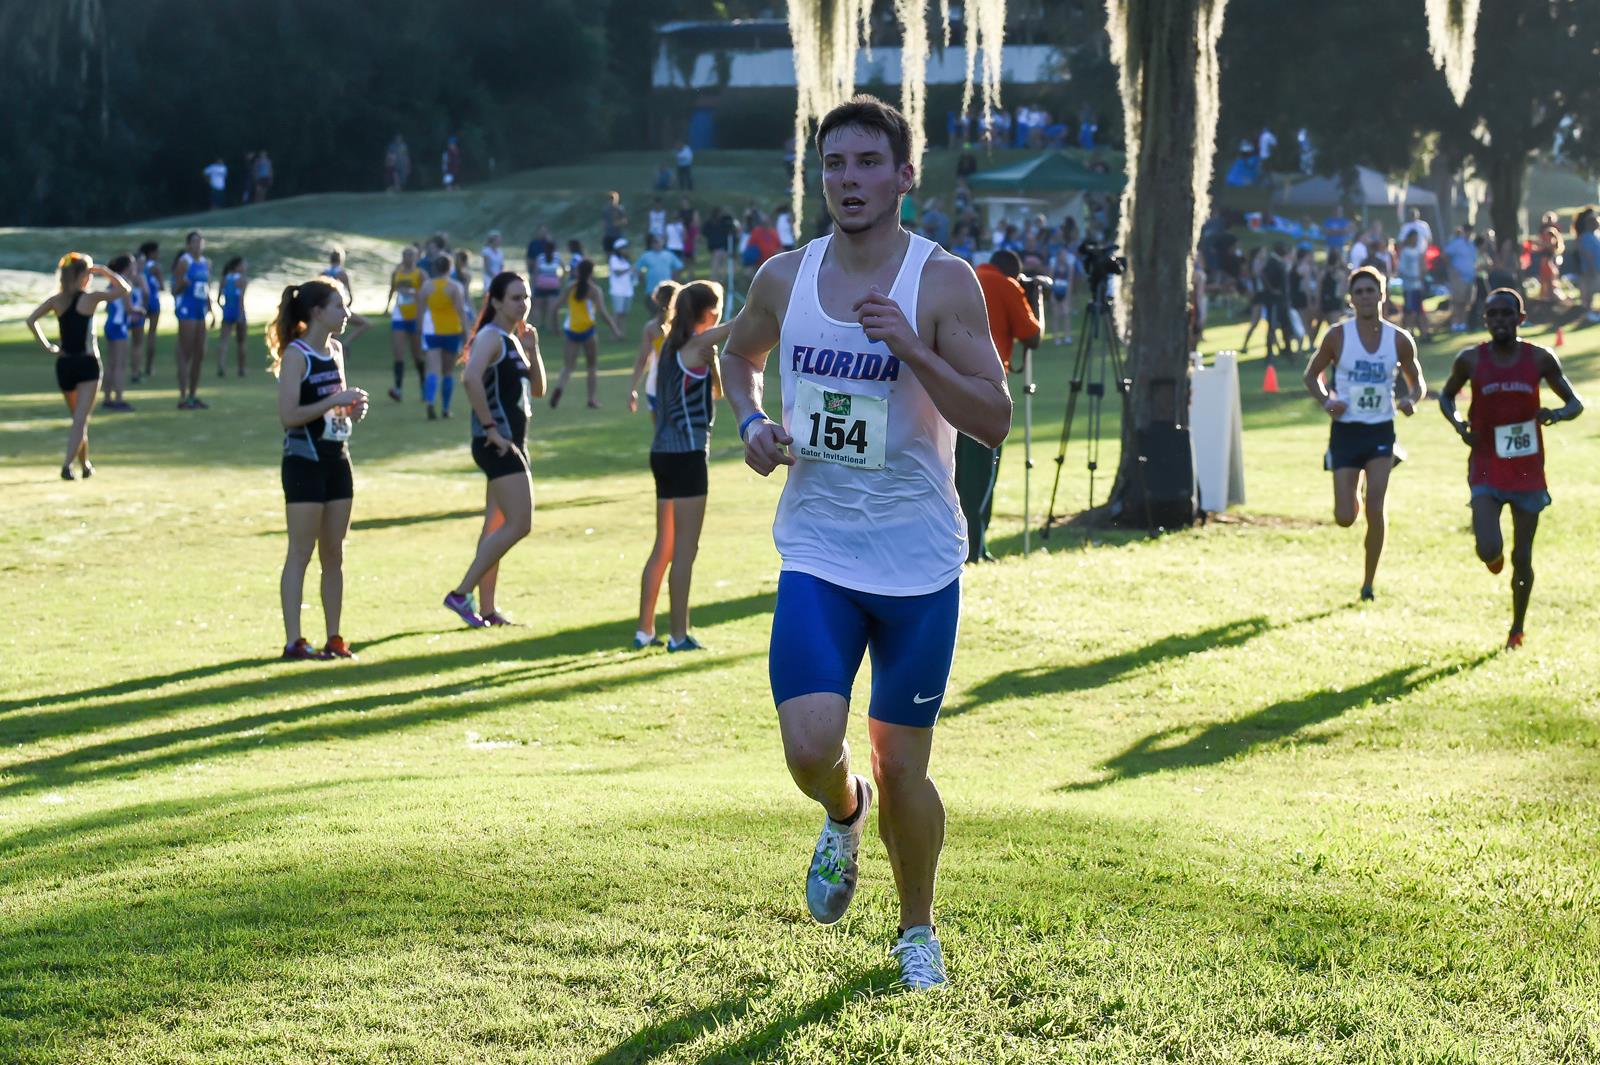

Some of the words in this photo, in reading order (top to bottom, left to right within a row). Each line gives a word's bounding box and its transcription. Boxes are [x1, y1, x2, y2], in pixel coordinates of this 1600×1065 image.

[792, 345, 900, 381] FLORIDA
[1357, 395, 1382, 409] 447
[809, 412, 868, 454] 154
[801, 447, 821, 458] Gator
[823, 451, 866, 465] Invitational
